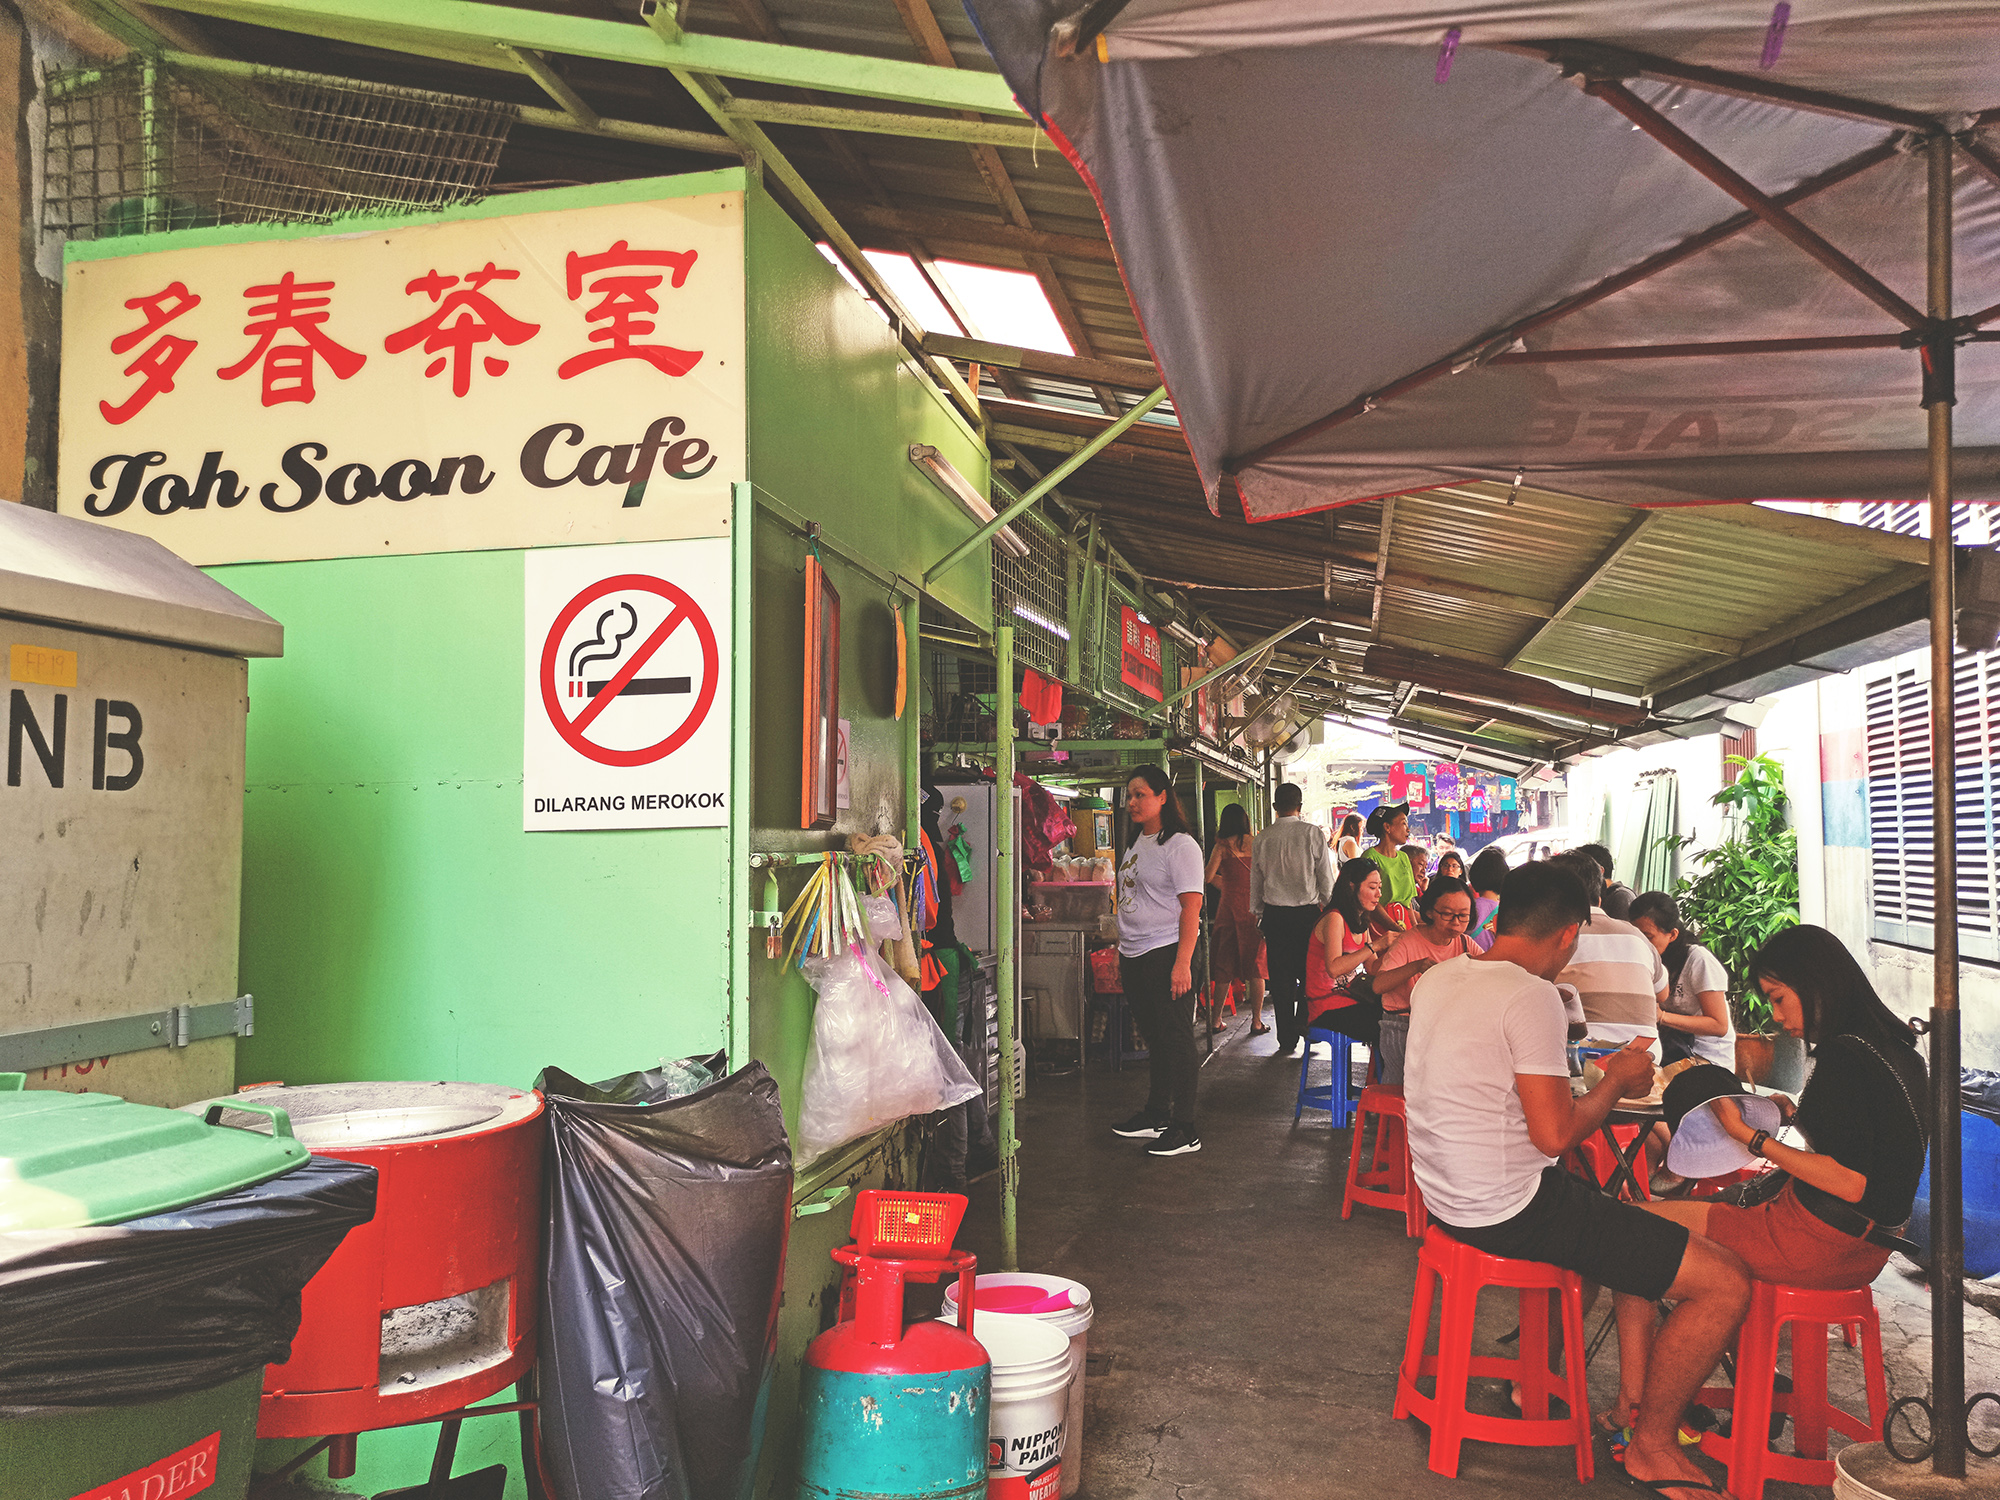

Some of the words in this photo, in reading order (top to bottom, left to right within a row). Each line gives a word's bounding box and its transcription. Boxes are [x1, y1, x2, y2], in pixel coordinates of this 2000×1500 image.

[99, 240, 704, 425] 多春茶室
[84, 450, 250, 517] Toh
[259, 442, 495, 514] Soon
[520, 416, 717, 508] Cafe
[534, 796, 625, 812] DILARANG
[631, 792, 725, 810] MEROKOK
[1019, 1438, 1060, 1465] PAINT
